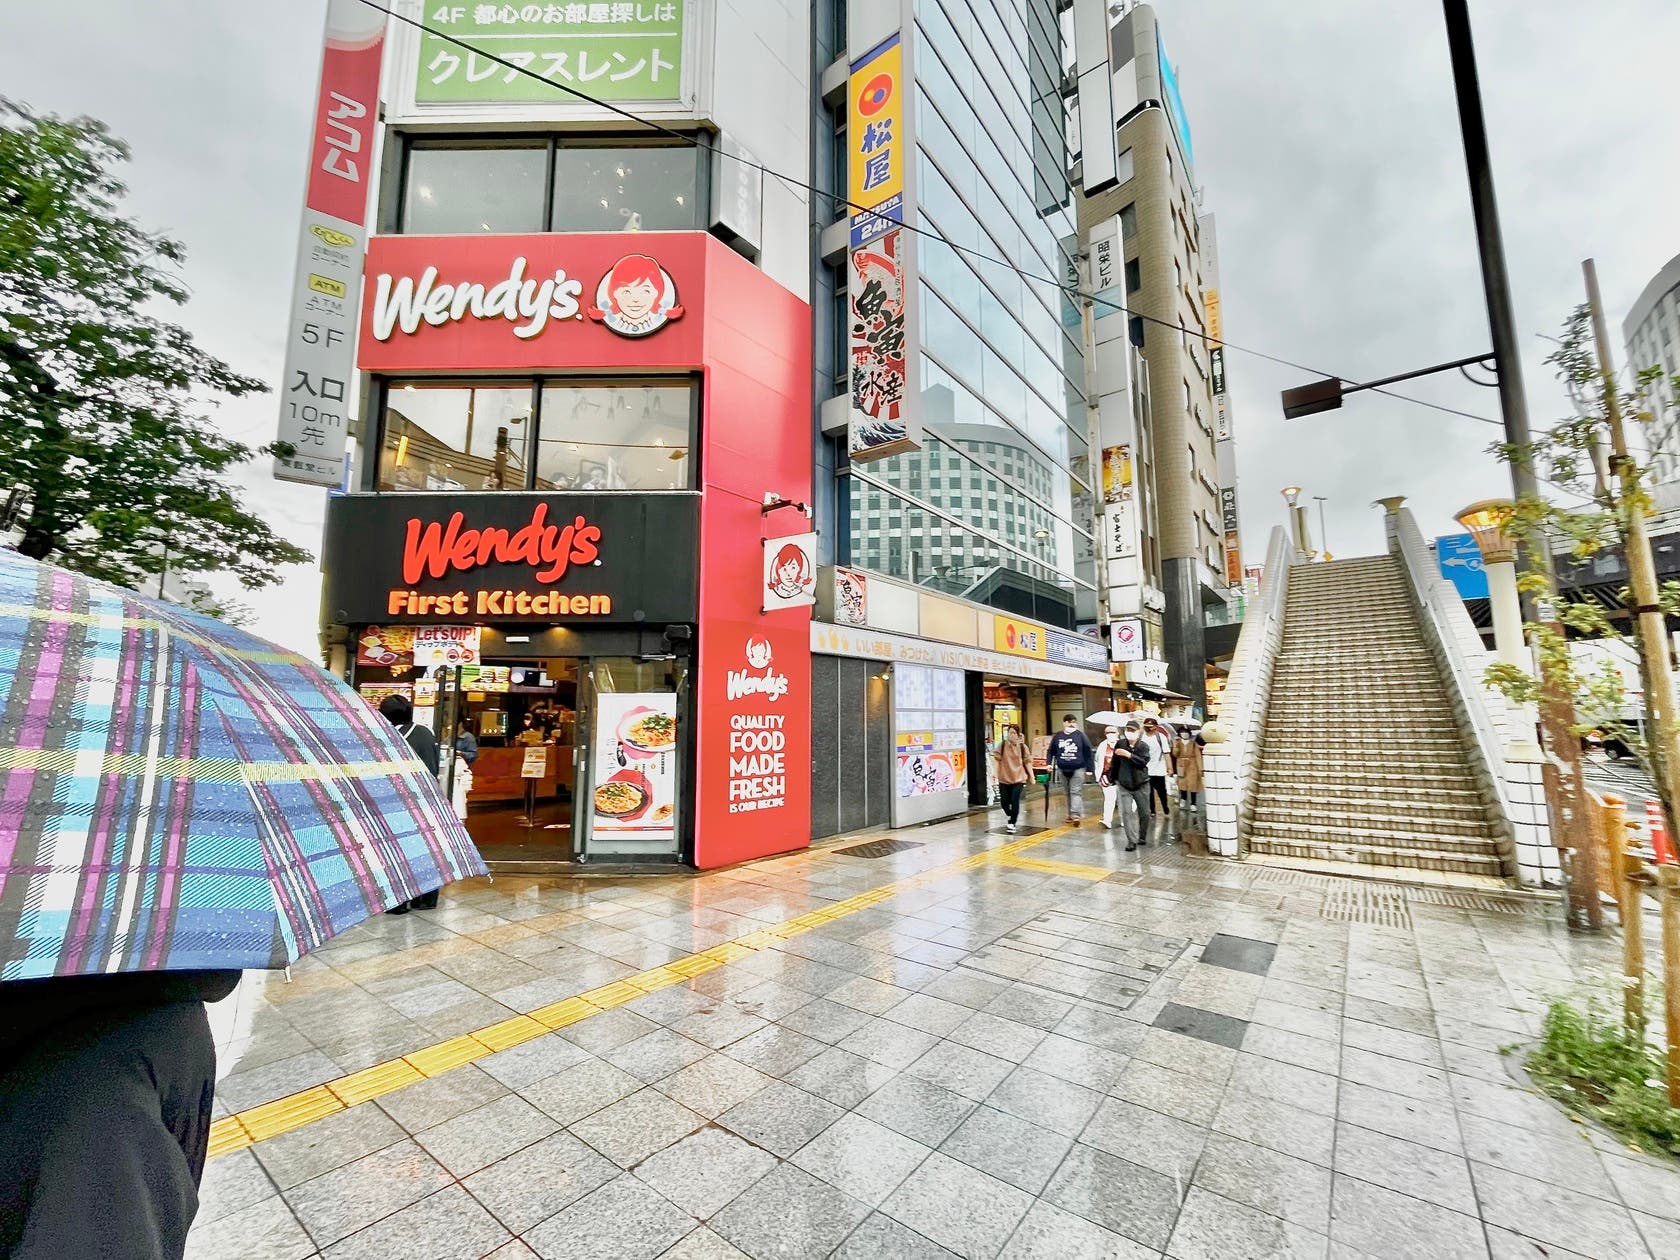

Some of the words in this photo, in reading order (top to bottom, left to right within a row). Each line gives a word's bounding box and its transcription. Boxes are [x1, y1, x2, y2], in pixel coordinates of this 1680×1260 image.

[432, 6, 465, 24] 4F
[474, 3, 677, 25] 都心のお部屋探しは
[427, 48, 674, 85] クレアスレント
[322, 90, 367, 183] アコム
[861, 118, 893, 192] 松屋
[314, 280, 341, 293] ATM
[372, 256, 584, 341] Wendy's
[301, 323, 345, 348] 5F
[290, 369, 345, 403] 入口
[861, 370, 903, 406] 水産
[289, 402, 341, 427] 10m
[300, 426, 326, 446] 先
[402, 502, 602, 585] Wendy's
[388, 590, 469, 616] First
[476, 590, 612, 616] Kitchen
[415, 626, 451, 641] Let's
[727, 667, 789, 702] Wendy's
[730, 714, 785, 731] QUALITY
[729, 731, 786, 753] FOOD
[729, 752, 786, 778] MADE
[729, 776, 786, 801] FRESH
[729, 803, 738, 814] IS
[757, 797, 785, 810] RECIPE
